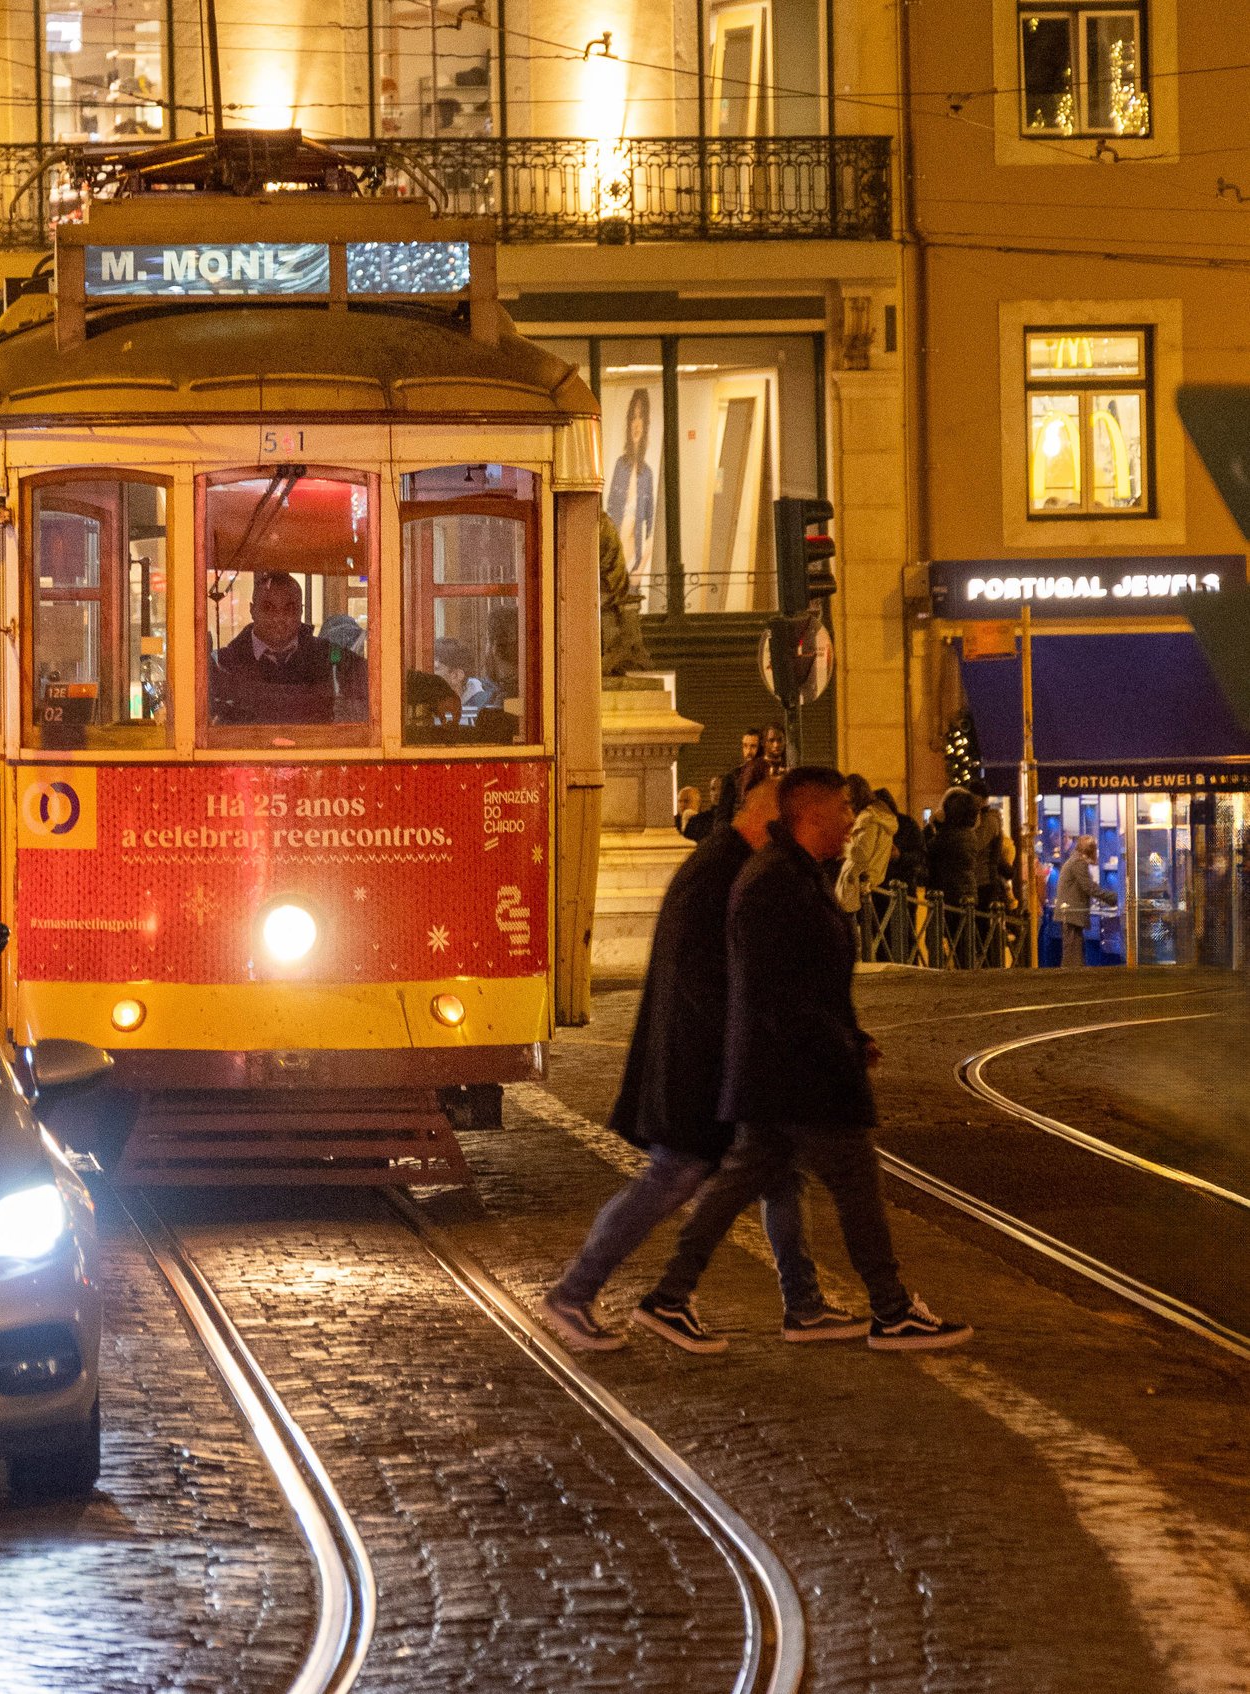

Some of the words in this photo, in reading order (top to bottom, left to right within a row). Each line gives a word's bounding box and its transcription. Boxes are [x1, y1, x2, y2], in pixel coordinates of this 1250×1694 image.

[100, 250, 148, 281] M.
[163, 249, 305, 282] MONIZ
[967, 576, 1108, 600] PORTUGAL
[48, 687, 67, 698] 12E
[44, 706, 64, 721] 02
[1059, 774, 1139, 788] PORTUGAL
[206, 792, 245, 817] Há
[253, 793, 288, 817] 25
[295, 796, 366, 817] anos
[484, 806, 501, 819] DO
[484, 820, 525, 833] CHIADO
[121, 828, 137, 848] a
[143, 825, 266, 849] celebrar
[272, 826, 453, 848] reencontros.
[30, 917, 155, 932] #xmasmeetingpoin
